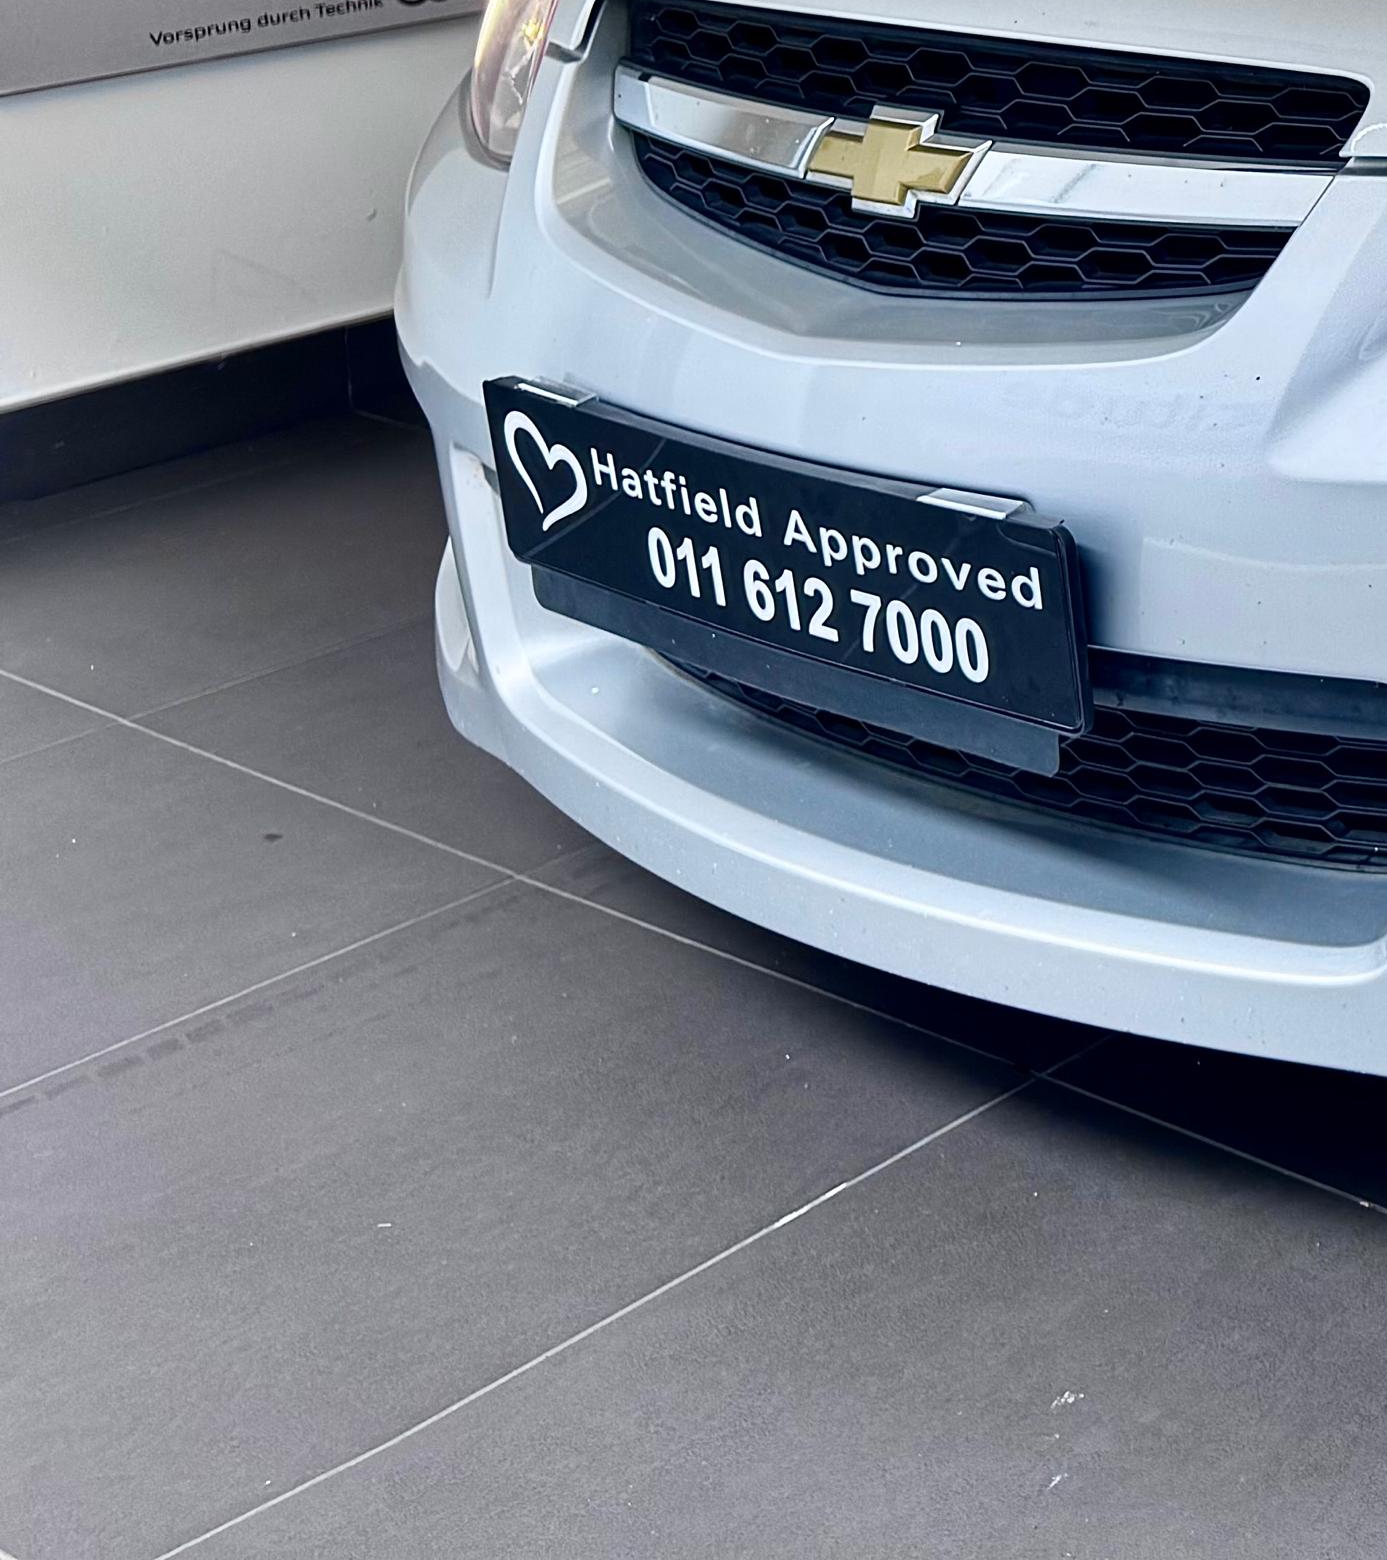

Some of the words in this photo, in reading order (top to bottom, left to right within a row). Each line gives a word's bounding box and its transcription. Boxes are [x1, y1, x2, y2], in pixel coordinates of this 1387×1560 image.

[149, 18, 251, 46] Vorsprung
[257, 8, 311, 27] durch
[590, 446, 764, 540] Hatfield
[784, 508, 1045, 612] Approved
[647, 526, 728, 609] 011
[743, 558, 840, 644] 612
[850, 588, 992, 686] 7000
